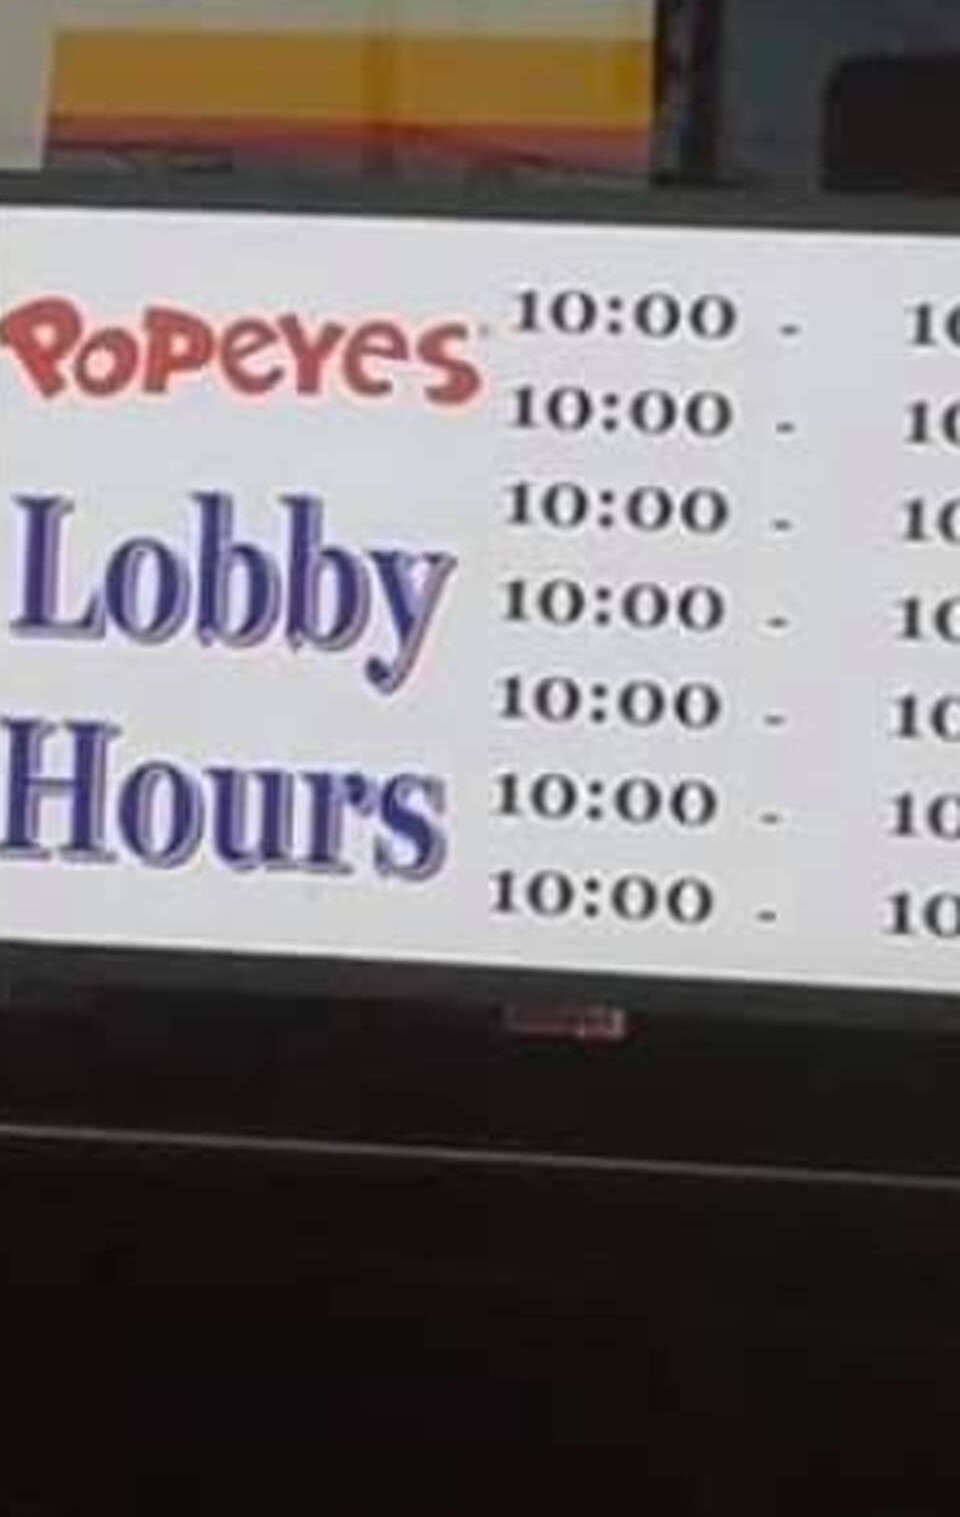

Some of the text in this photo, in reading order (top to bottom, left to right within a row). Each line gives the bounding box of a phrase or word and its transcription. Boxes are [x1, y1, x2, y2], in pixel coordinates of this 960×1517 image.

[517, 291, 736, 339] 10:00
[513, 386, 732, 437] 10:00
[506, 483, 729, 534] 10:00
[8, 491, 458, 694] Lobby
[504, 580, 724, 632] 10:00
[498, 677, 721, 729] 10:00
[493, 773, 717, 827] 10:00
[490, 870, 713, 925] 10:00
[887, 891, 960, 939] 10
